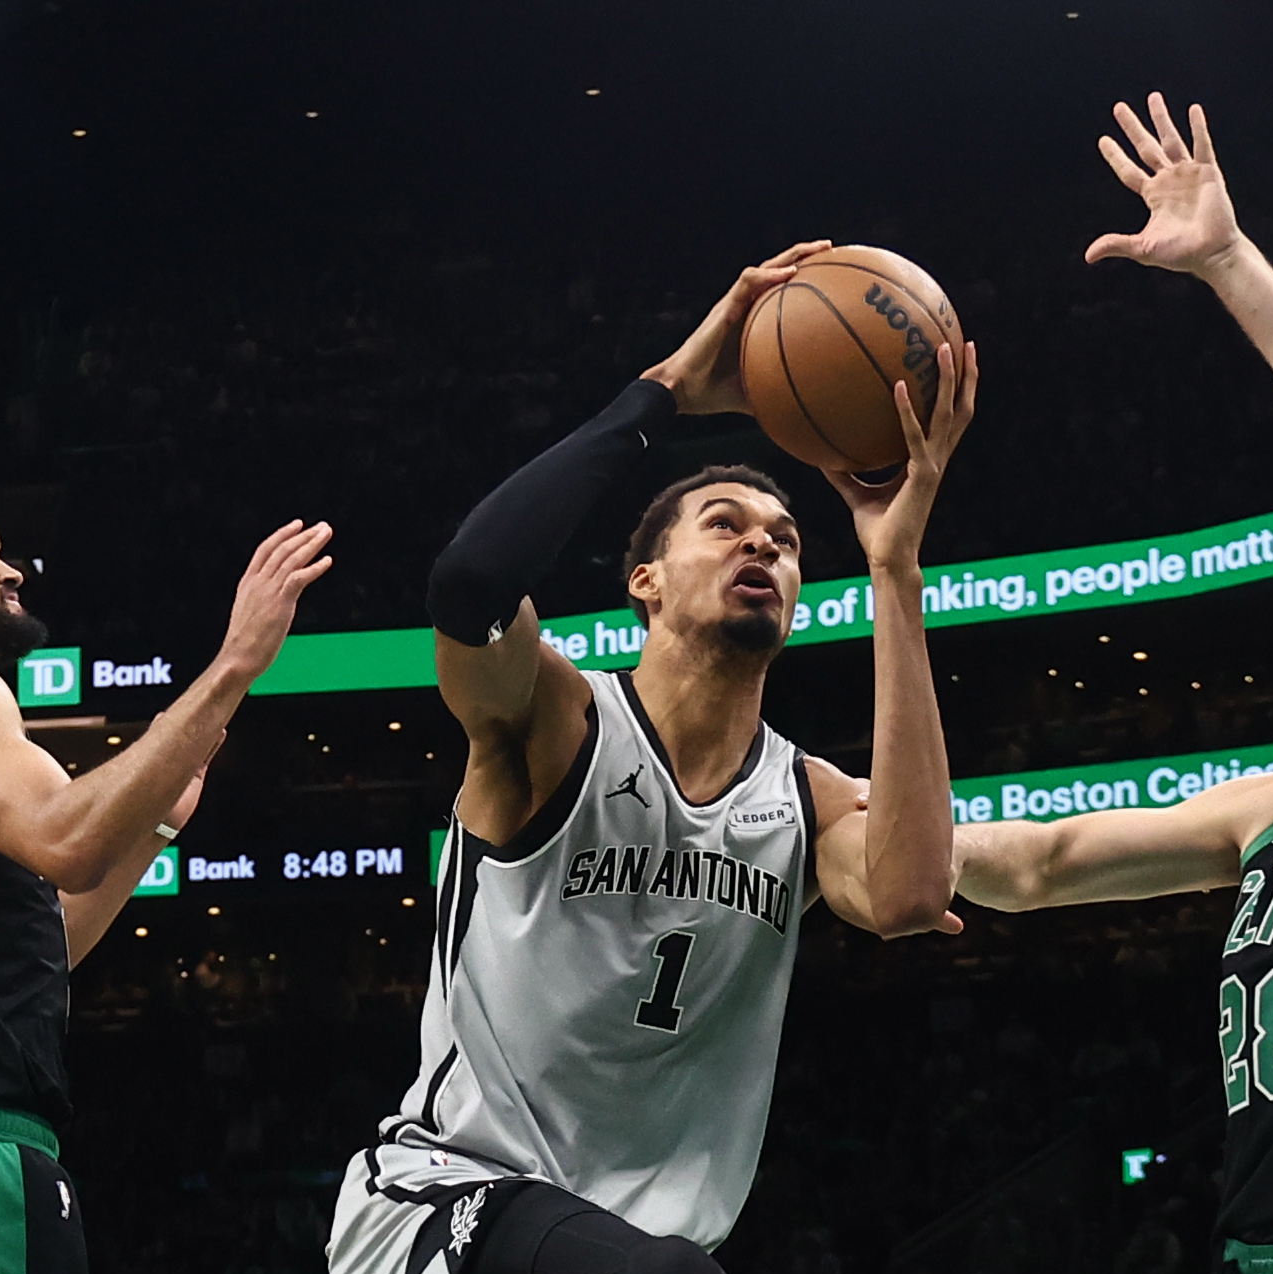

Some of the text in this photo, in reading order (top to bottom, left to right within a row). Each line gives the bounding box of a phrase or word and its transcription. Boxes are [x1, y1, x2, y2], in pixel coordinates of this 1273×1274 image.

[540, 627, 589, 661] he
[817, 586, 859, 624] of
[865, 572, 1038, 622] nking,
[1046, 548, 1186, 605] people
[23, 656, 172, 696] TD Bank
[735, 809, 785, 824] LEDGER
[951, 791, 994, 823] he
[1001, 780, 1139, 819] Boston
[188, 854, 255, 881] Bank
[283, 847, 403, 879] 8:48 PM
[561, 845, 791, 937] SAN ANTONIO
[633, 929, 697, 1034] 1
